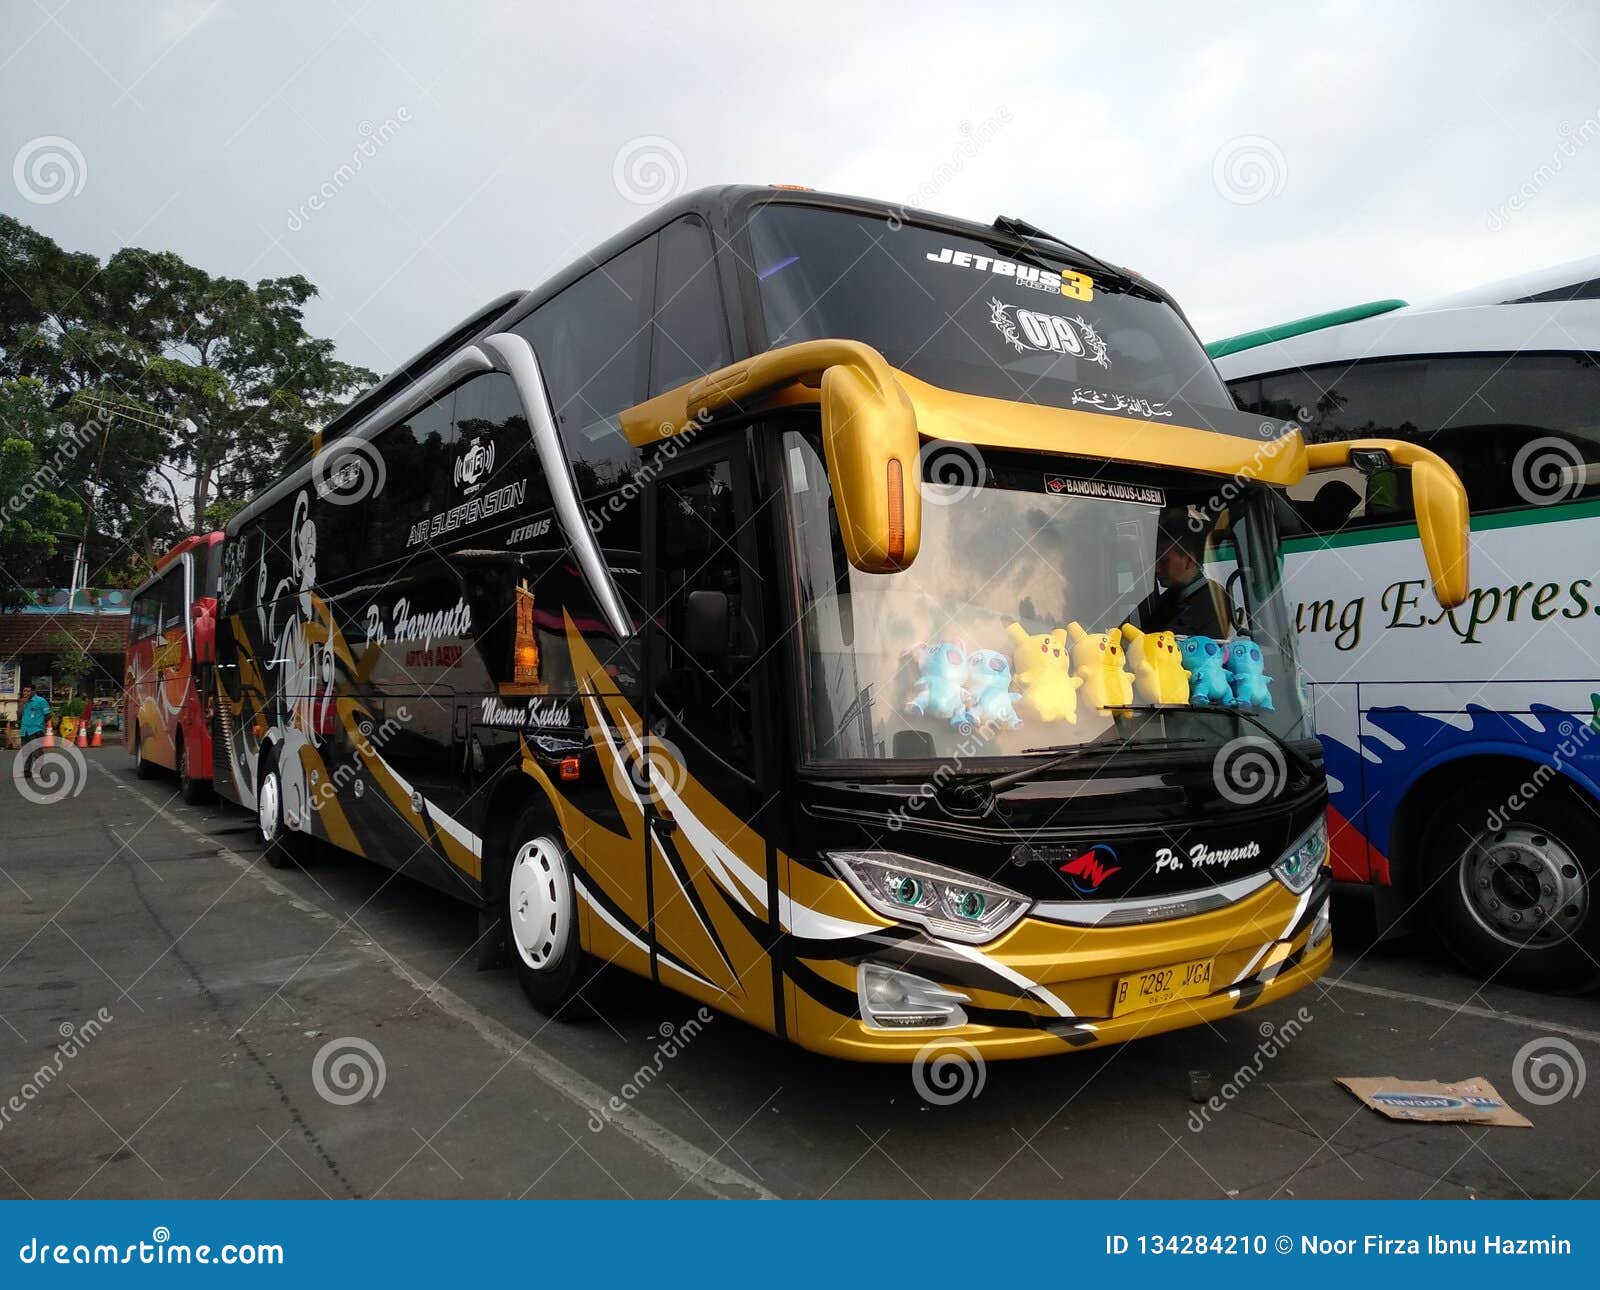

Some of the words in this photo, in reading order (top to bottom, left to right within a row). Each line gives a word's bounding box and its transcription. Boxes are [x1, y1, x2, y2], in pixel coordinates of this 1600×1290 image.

[1017, 309, 1086, 357] 079
[1066, 479, 1163, 503] BANDUNG-KUDUS-LASEM
[406, 519, 430, 548] AIR
[430, 479, 528, 540] SUSPENSION
[506, 518, 551, 546] JETBUS
[393, 597, 472, 651] Haryanto
[481, 697, 527, 725] Menara
[526, 697, 571, 727] Kudus
[1189, 841, 1261, 868] Haryanto
[1118, 982, 1129, 1004] B
[1139, 970, 1174, 997] 7282
